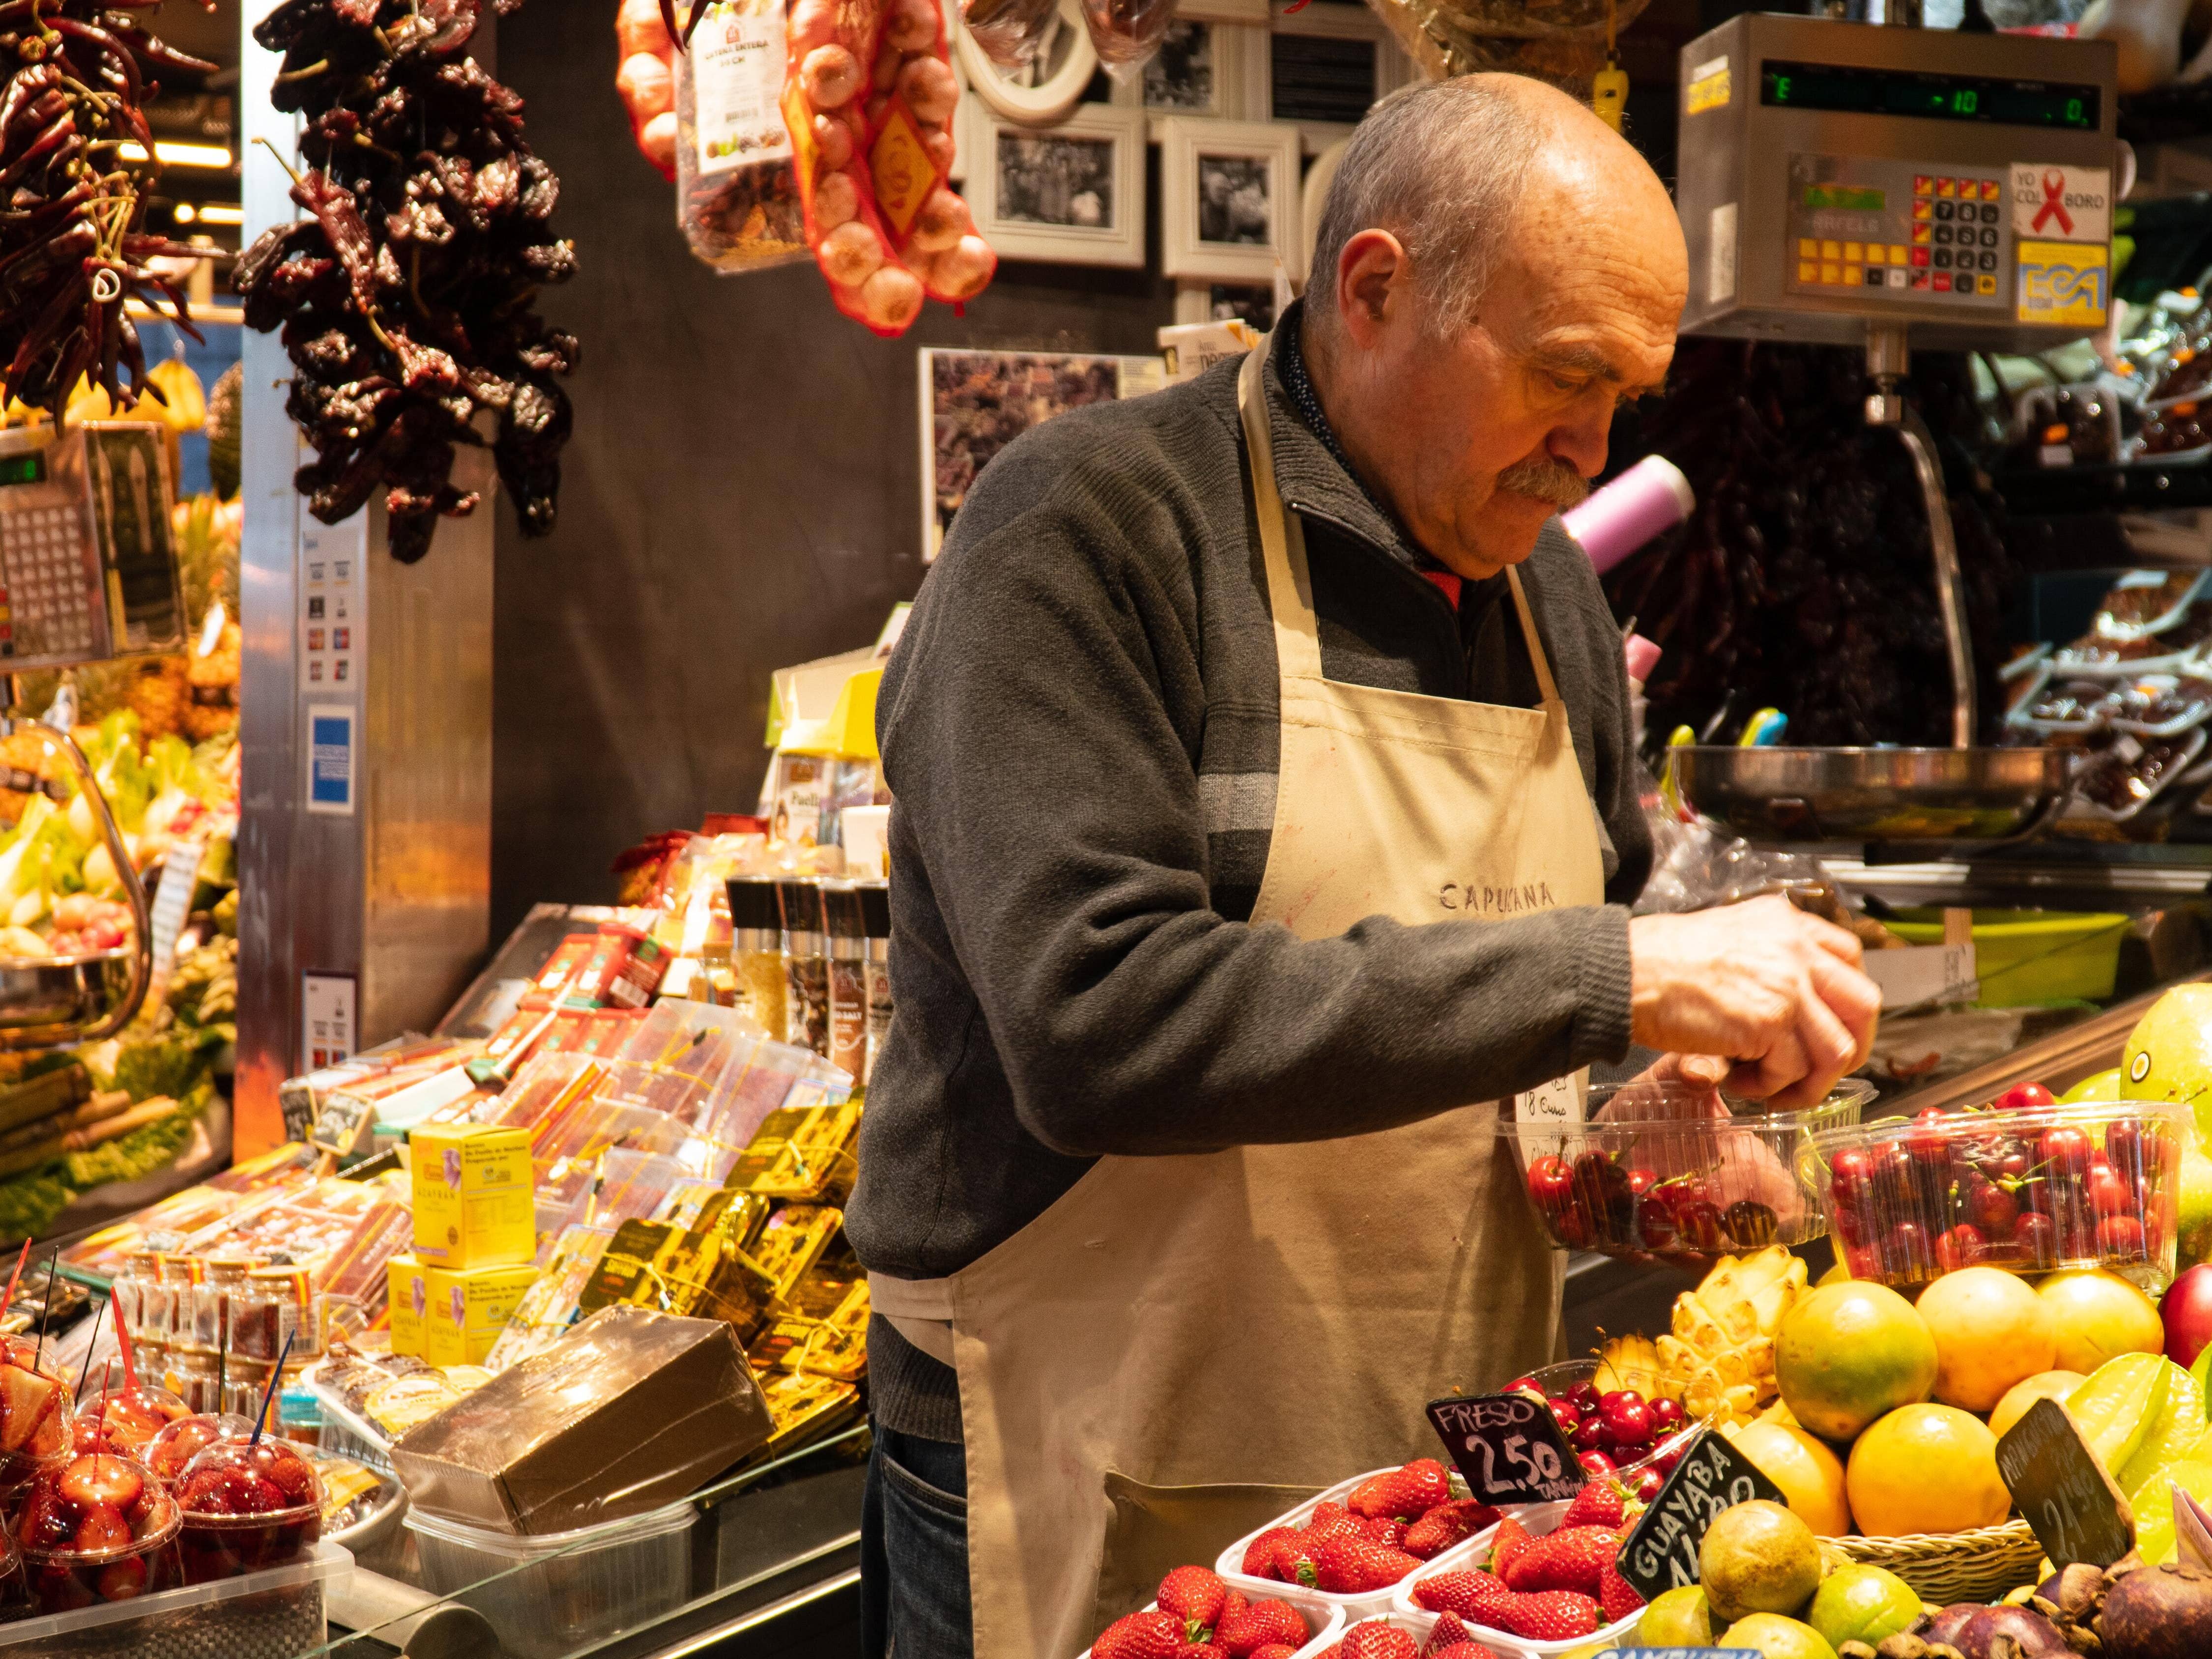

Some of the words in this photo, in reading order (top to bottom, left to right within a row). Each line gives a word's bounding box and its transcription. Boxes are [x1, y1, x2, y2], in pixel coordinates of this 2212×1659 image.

[2017, 172, 2035, 186] YO
[2065, 193, 2104, 209] BORO
[1434, 1400, 1535, 1433] FRESO
[1635, 1440, 1731, 1579] GUAYABA
